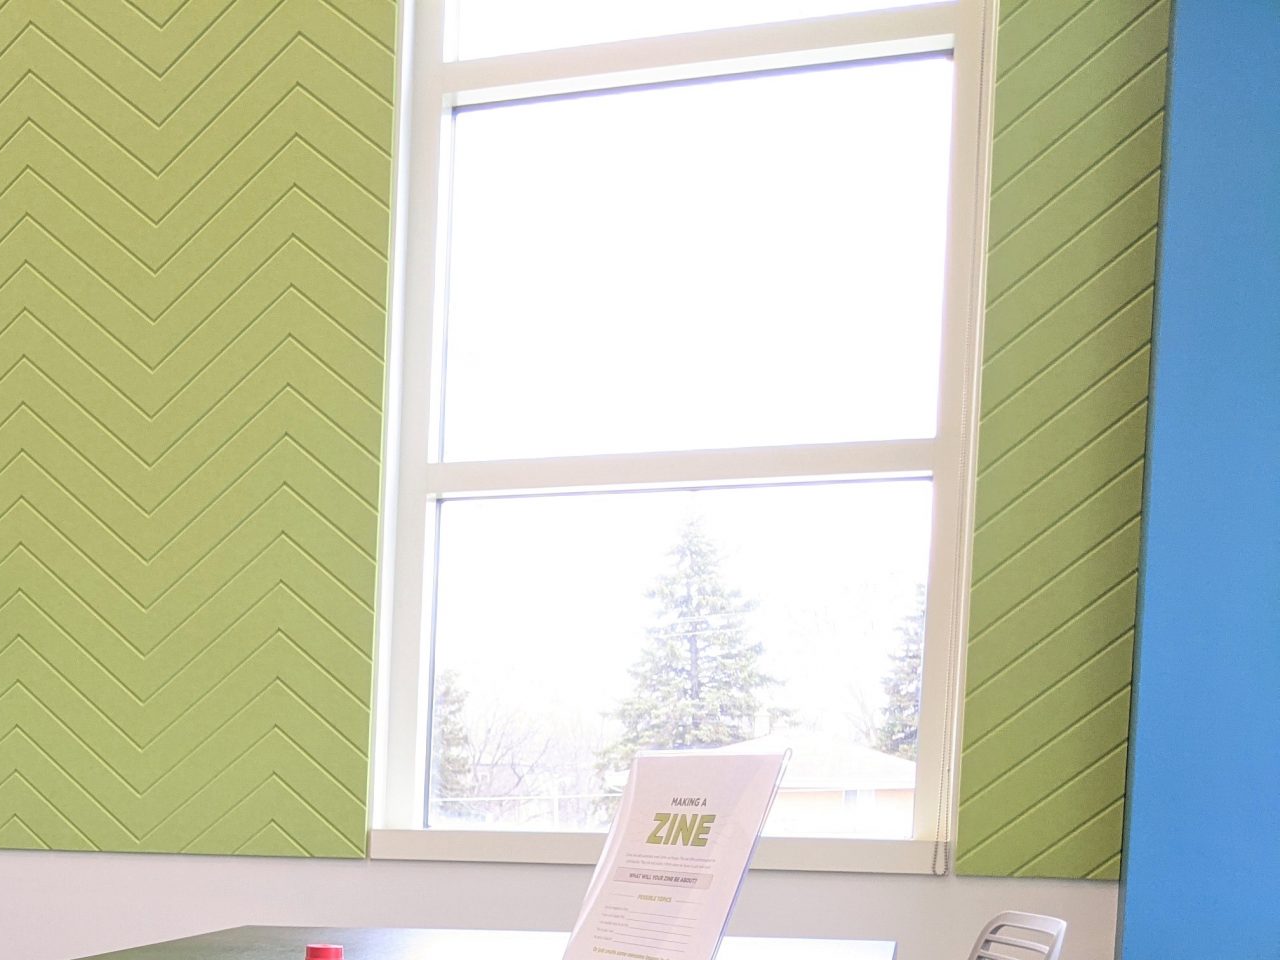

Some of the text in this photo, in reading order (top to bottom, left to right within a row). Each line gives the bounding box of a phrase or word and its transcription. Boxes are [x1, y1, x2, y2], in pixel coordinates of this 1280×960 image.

[671, 797, 707, 807] MAKING A
[645, 812, 716, 848] ZINE
